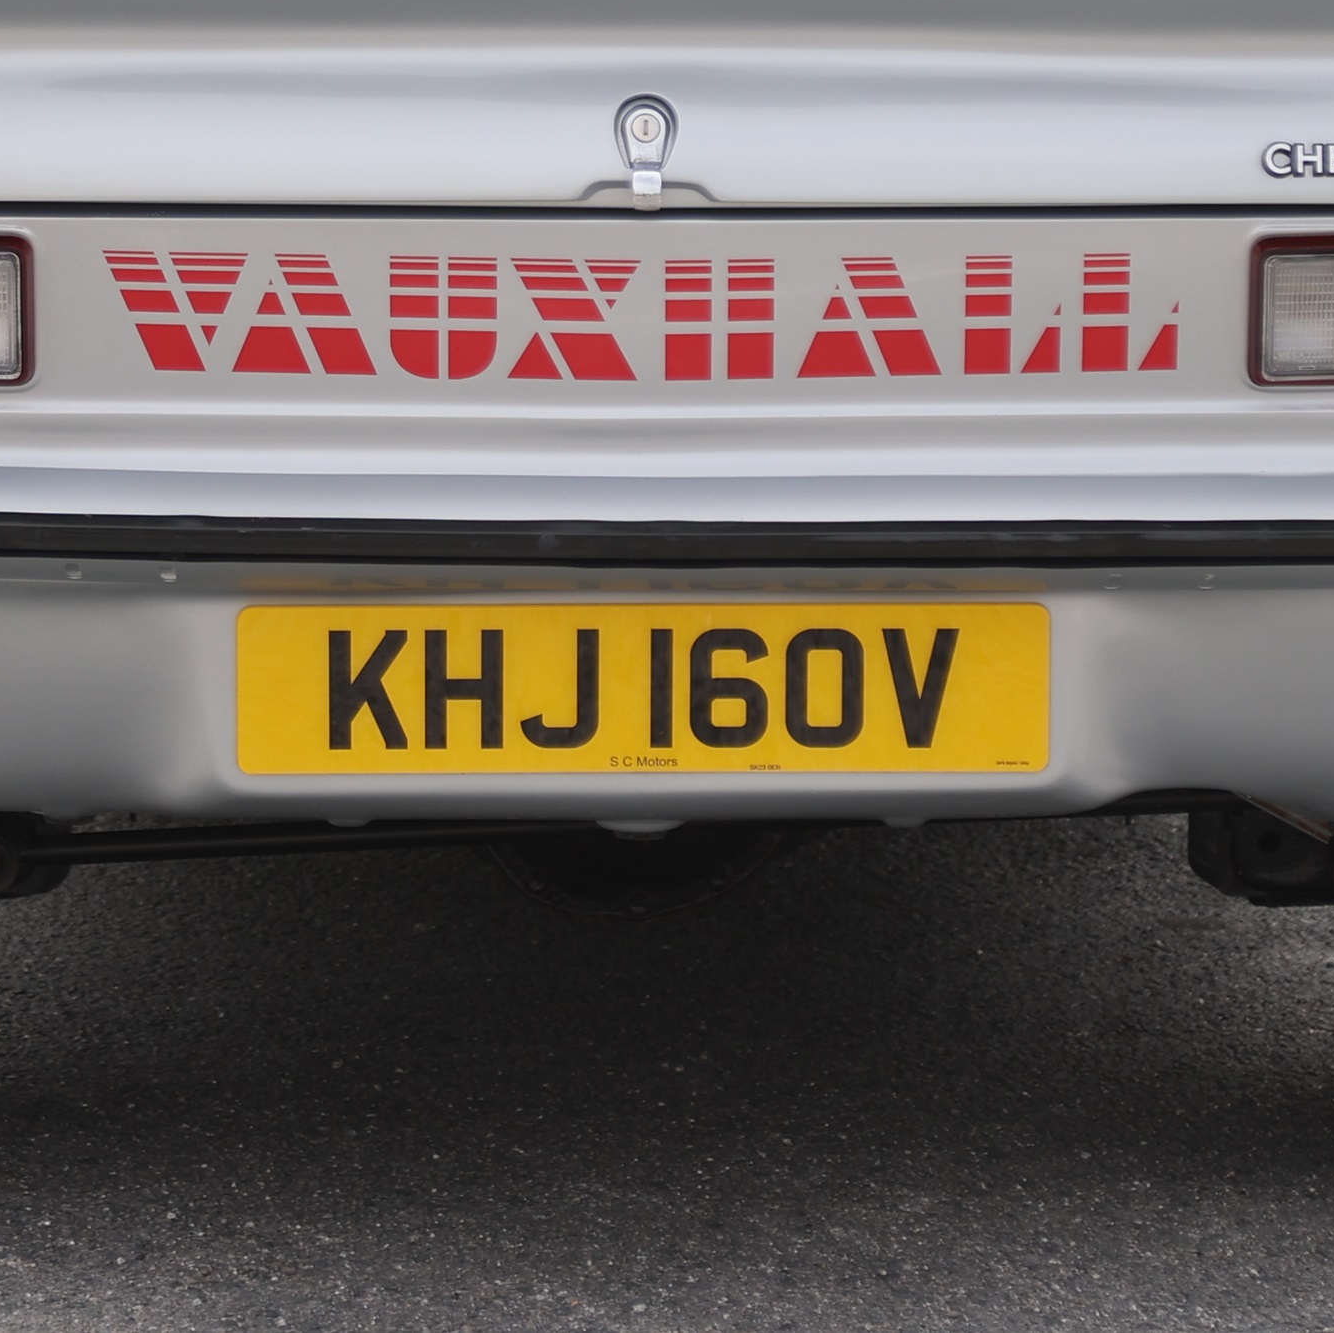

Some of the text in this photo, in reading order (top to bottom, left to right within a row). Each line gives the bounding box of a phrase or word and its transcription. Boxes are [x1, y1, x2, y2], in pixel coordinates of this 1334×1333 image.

[102, 249, 1179, 381] VAUXHALL
[328, 628, 960, 750] KHJ 160V
[609, 756, 679, 767] S C Motors
